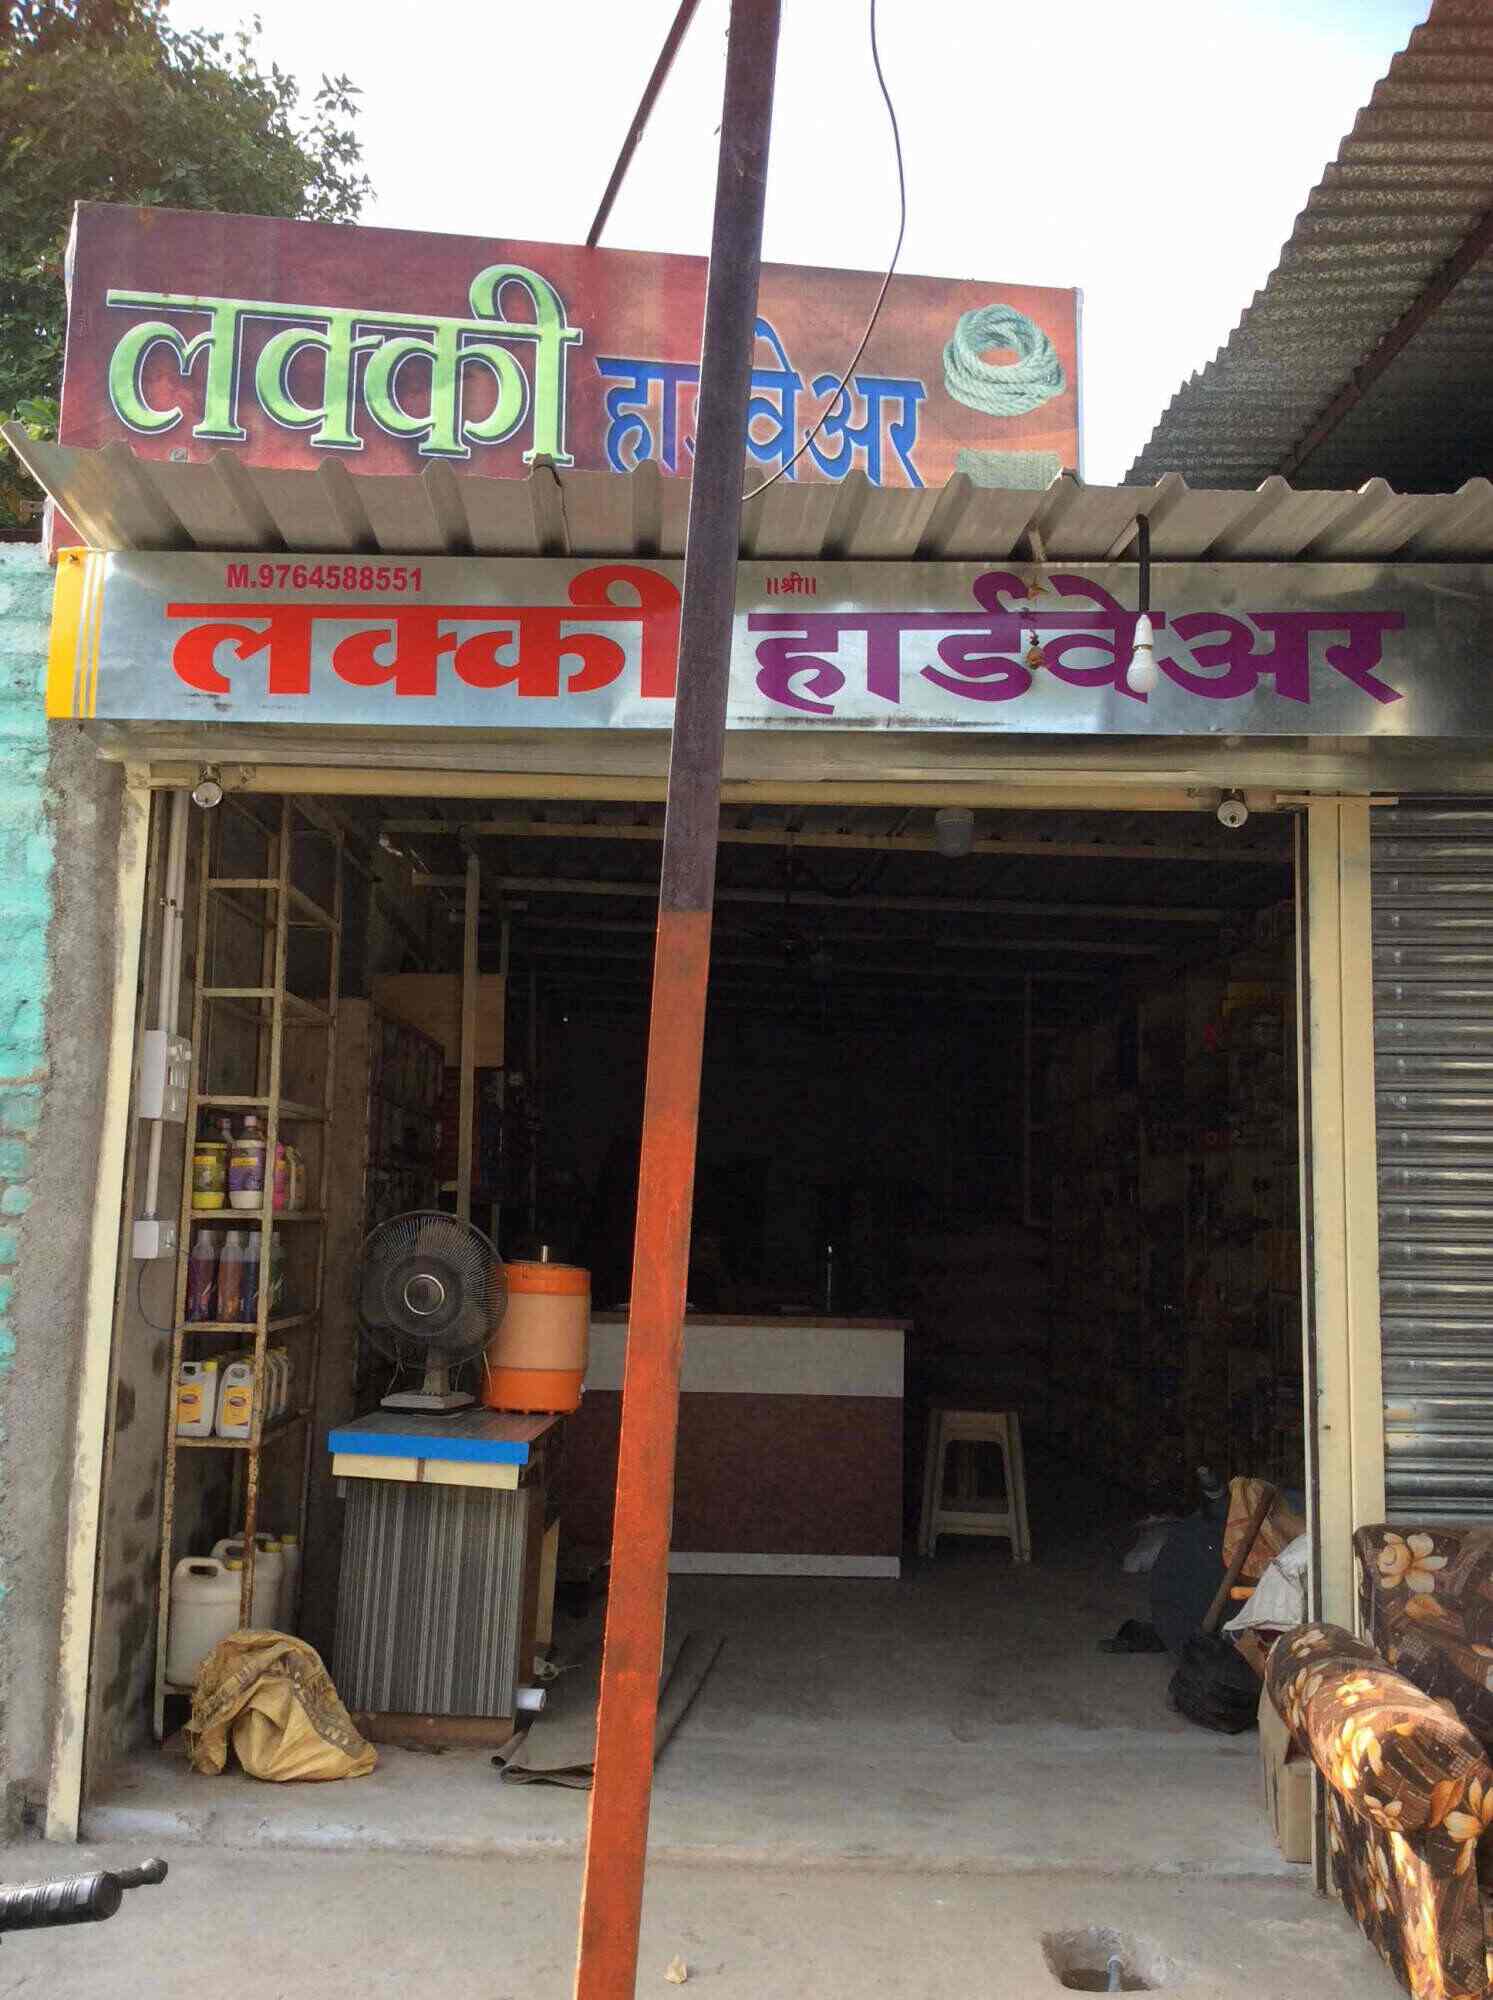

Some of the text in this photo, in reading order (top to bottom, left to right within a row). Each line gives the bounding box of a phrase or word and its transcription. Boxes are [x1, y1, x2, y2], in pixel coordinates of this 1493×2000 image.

[106, 263, 583, 467] लक्की
[167, 564, 1406, 714] लक्की हार्डवेअर
[226, 563, 423, 592] M.9764588551
